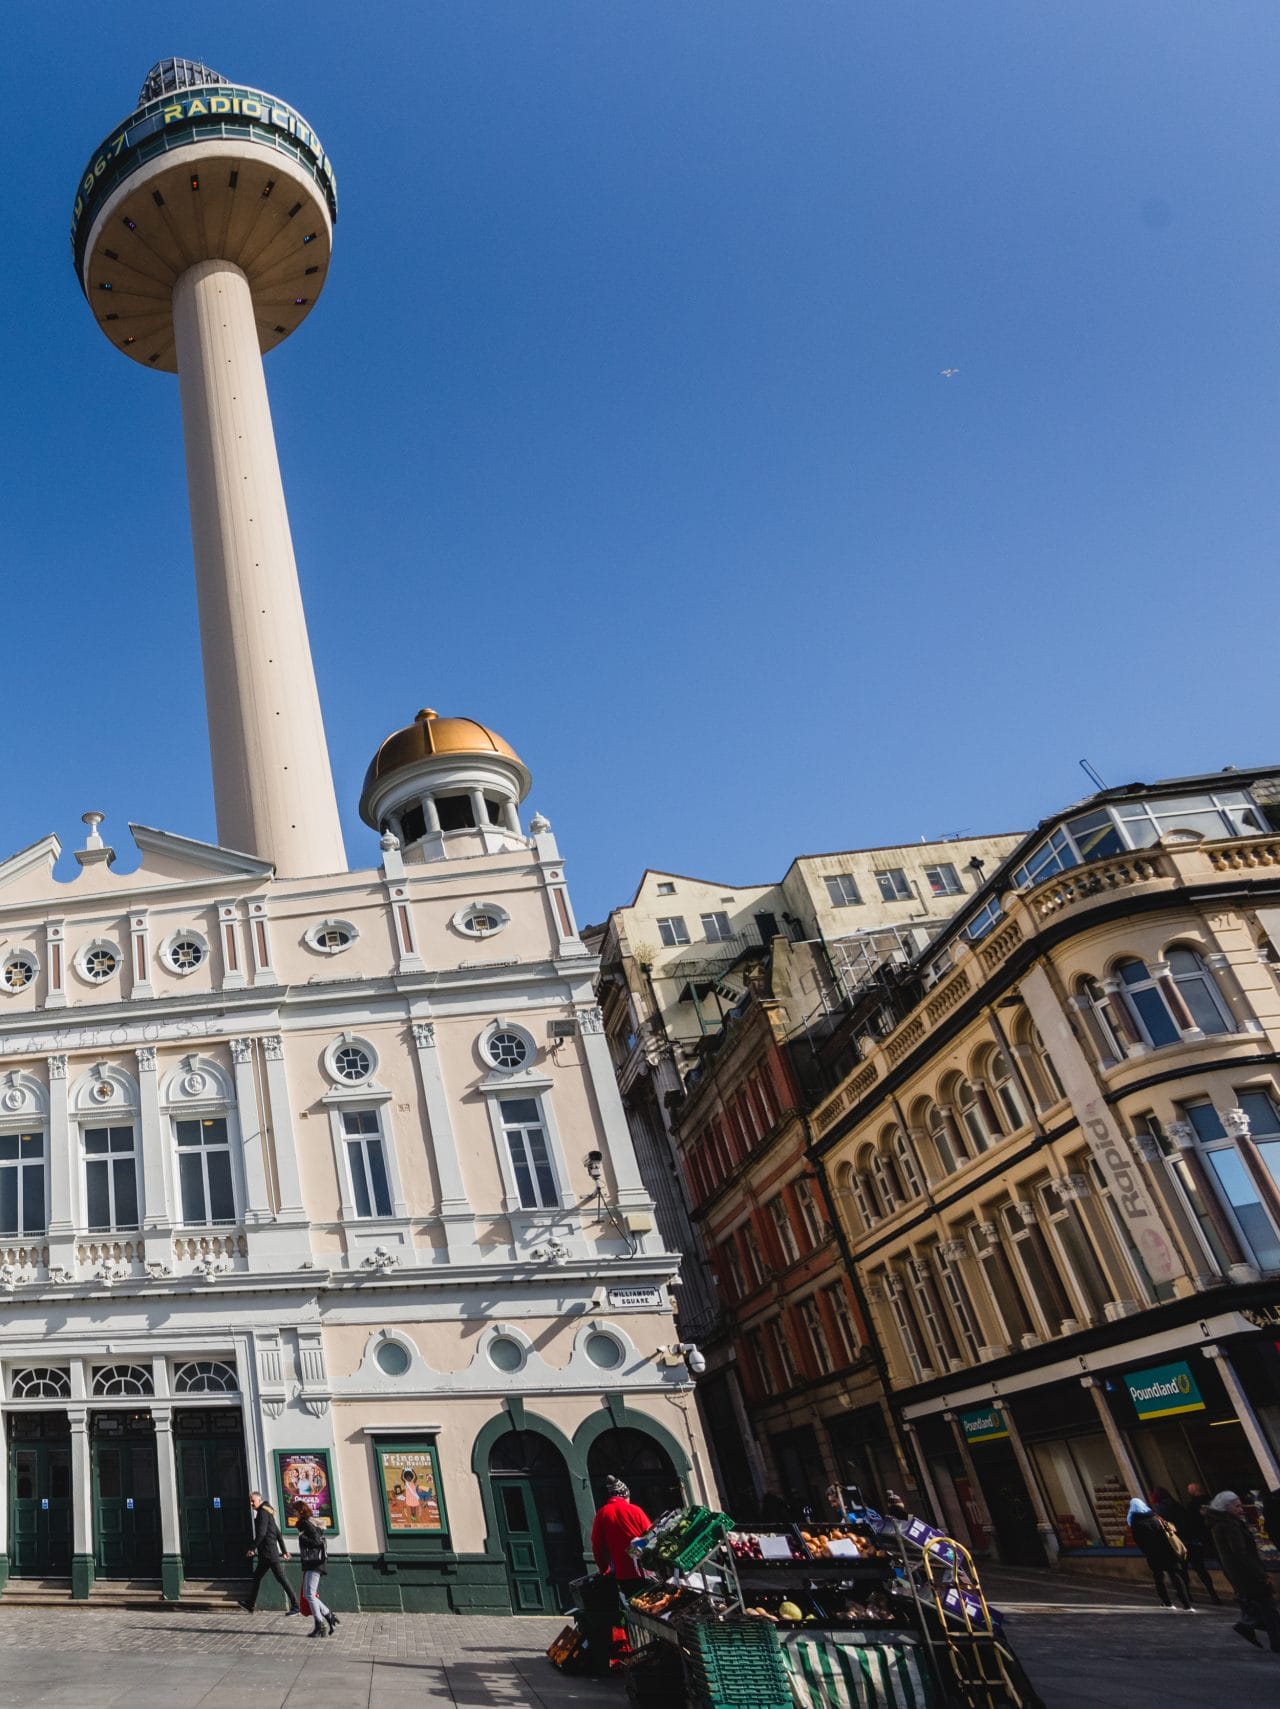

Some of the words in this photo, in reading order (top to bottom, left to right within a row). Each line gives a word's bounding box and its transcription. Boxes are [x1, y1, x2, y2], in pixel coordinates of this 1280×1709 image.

[164, 97, 261, 124] RADIO
[84, 132, 125, 194] 96.7
[1085, 1117, 1148, 1219] Rapid
[613, 1290, 655, 1298] WILLIAMSON
[1129, 1378, 1180, 1402] Poundland
[963, 1416, 994, 1432] Poundland
[382, 1453, 432, 1462] Princess
